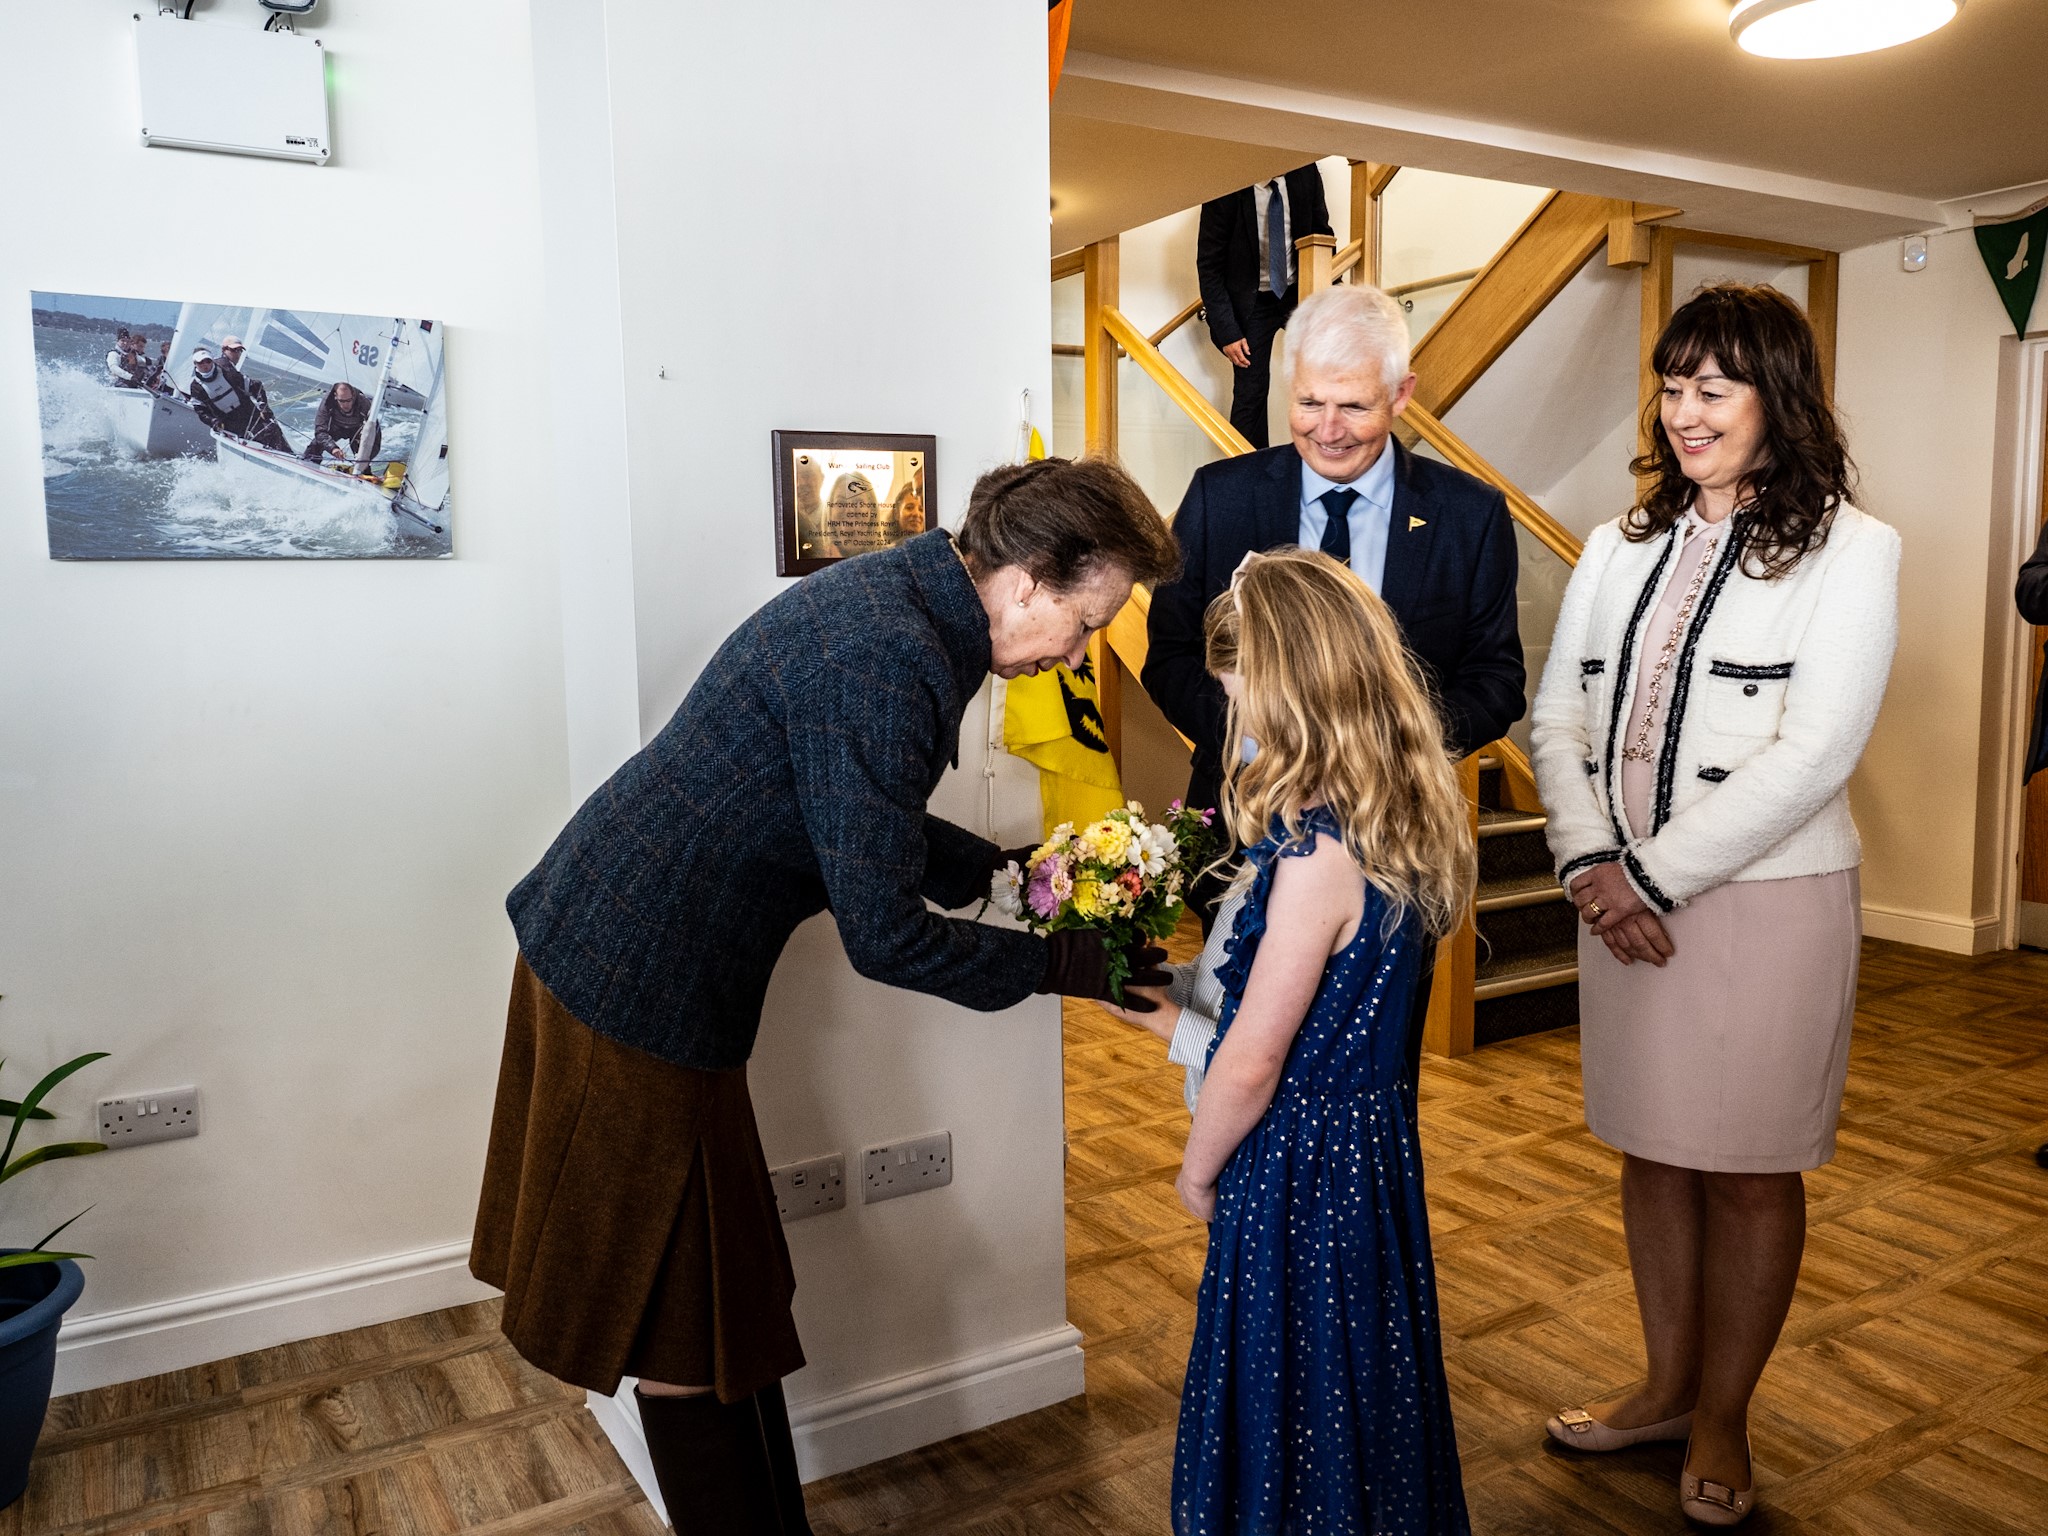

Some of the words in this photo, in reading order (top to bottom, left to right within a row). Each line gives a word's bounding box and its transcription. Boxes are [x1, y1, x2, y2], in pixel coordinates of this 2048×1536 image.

[855, 462, 875, 471] Sailing
[846, 511, 868, 519] opened
[870, 511, 878, 519] by
[839, 530, 855, 538] Royal
[857, 530, 881, 538] Yachting
